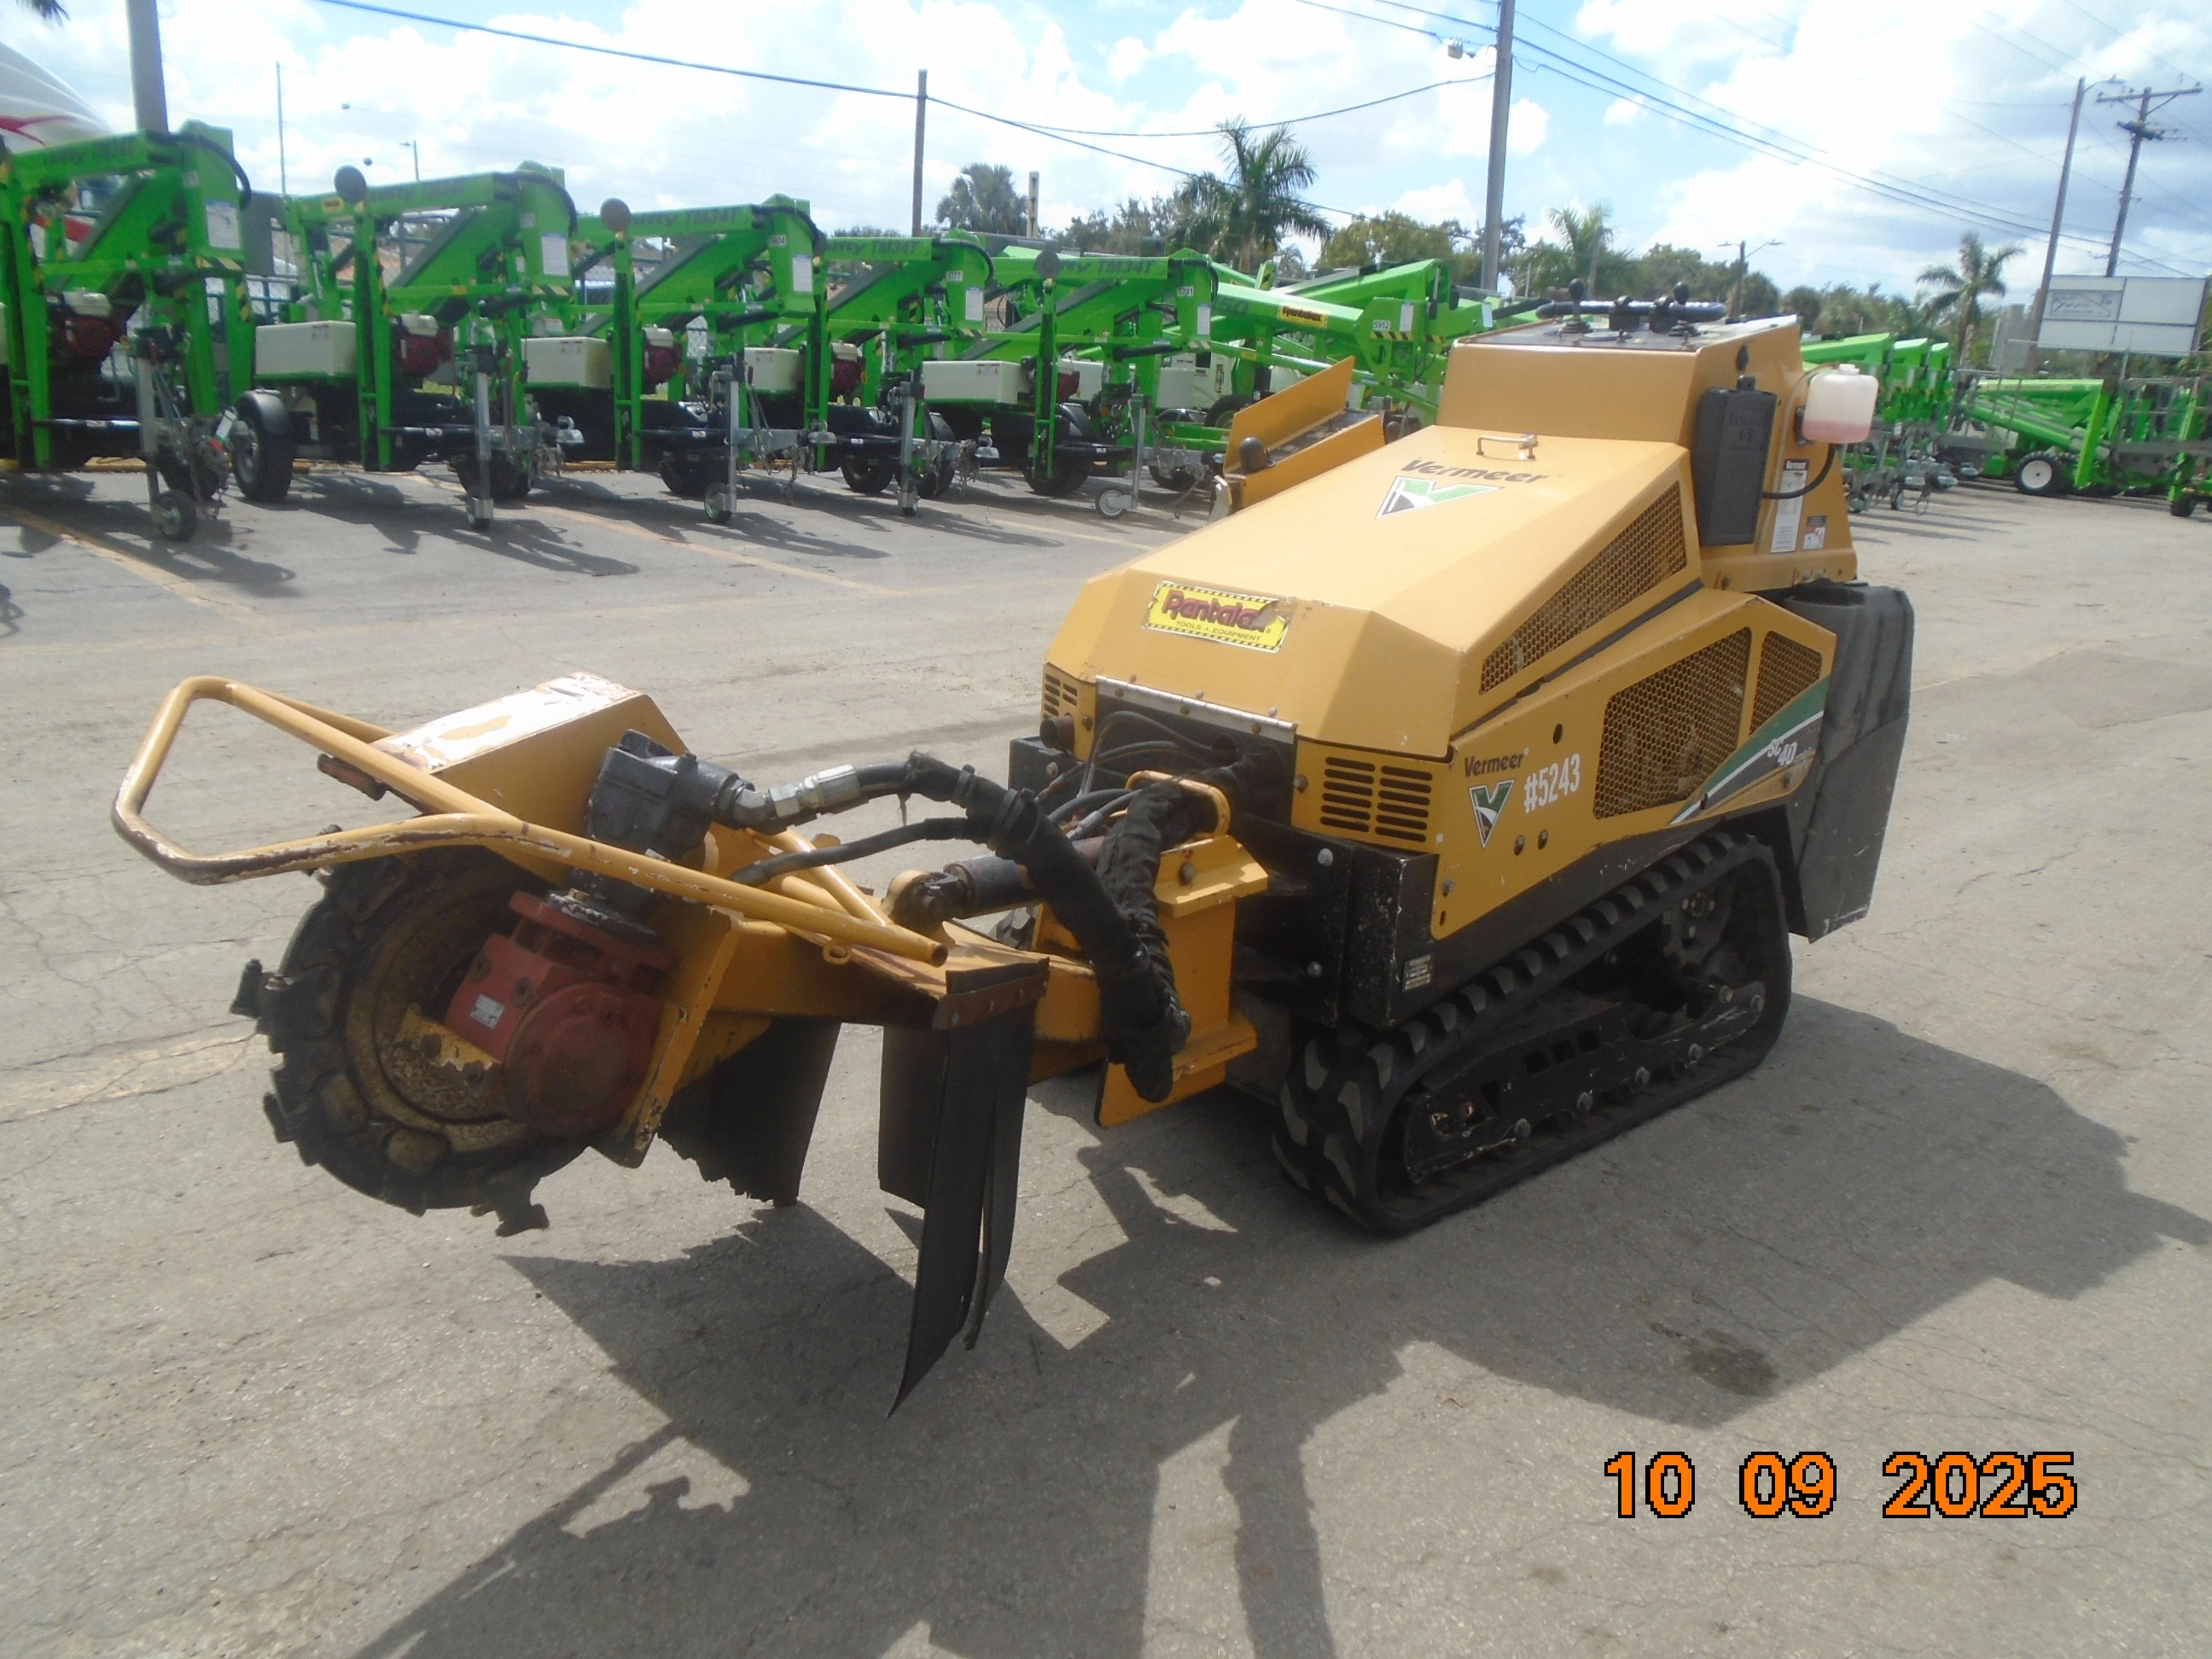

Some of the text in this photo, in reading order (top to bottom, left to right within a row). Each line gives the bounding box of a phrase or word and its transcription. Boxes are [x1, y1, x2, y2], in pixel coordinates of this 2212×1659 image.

[1401, 458, 1550, 484] Vermeer
[1161, 589, 1266, 633] Rentale
[1176, 620, 1261, 642] TOOLS EQUIPMENT
[1464, 753, 1524, 777] Vermeer
[1523, 753, 1580, 813] #5243
